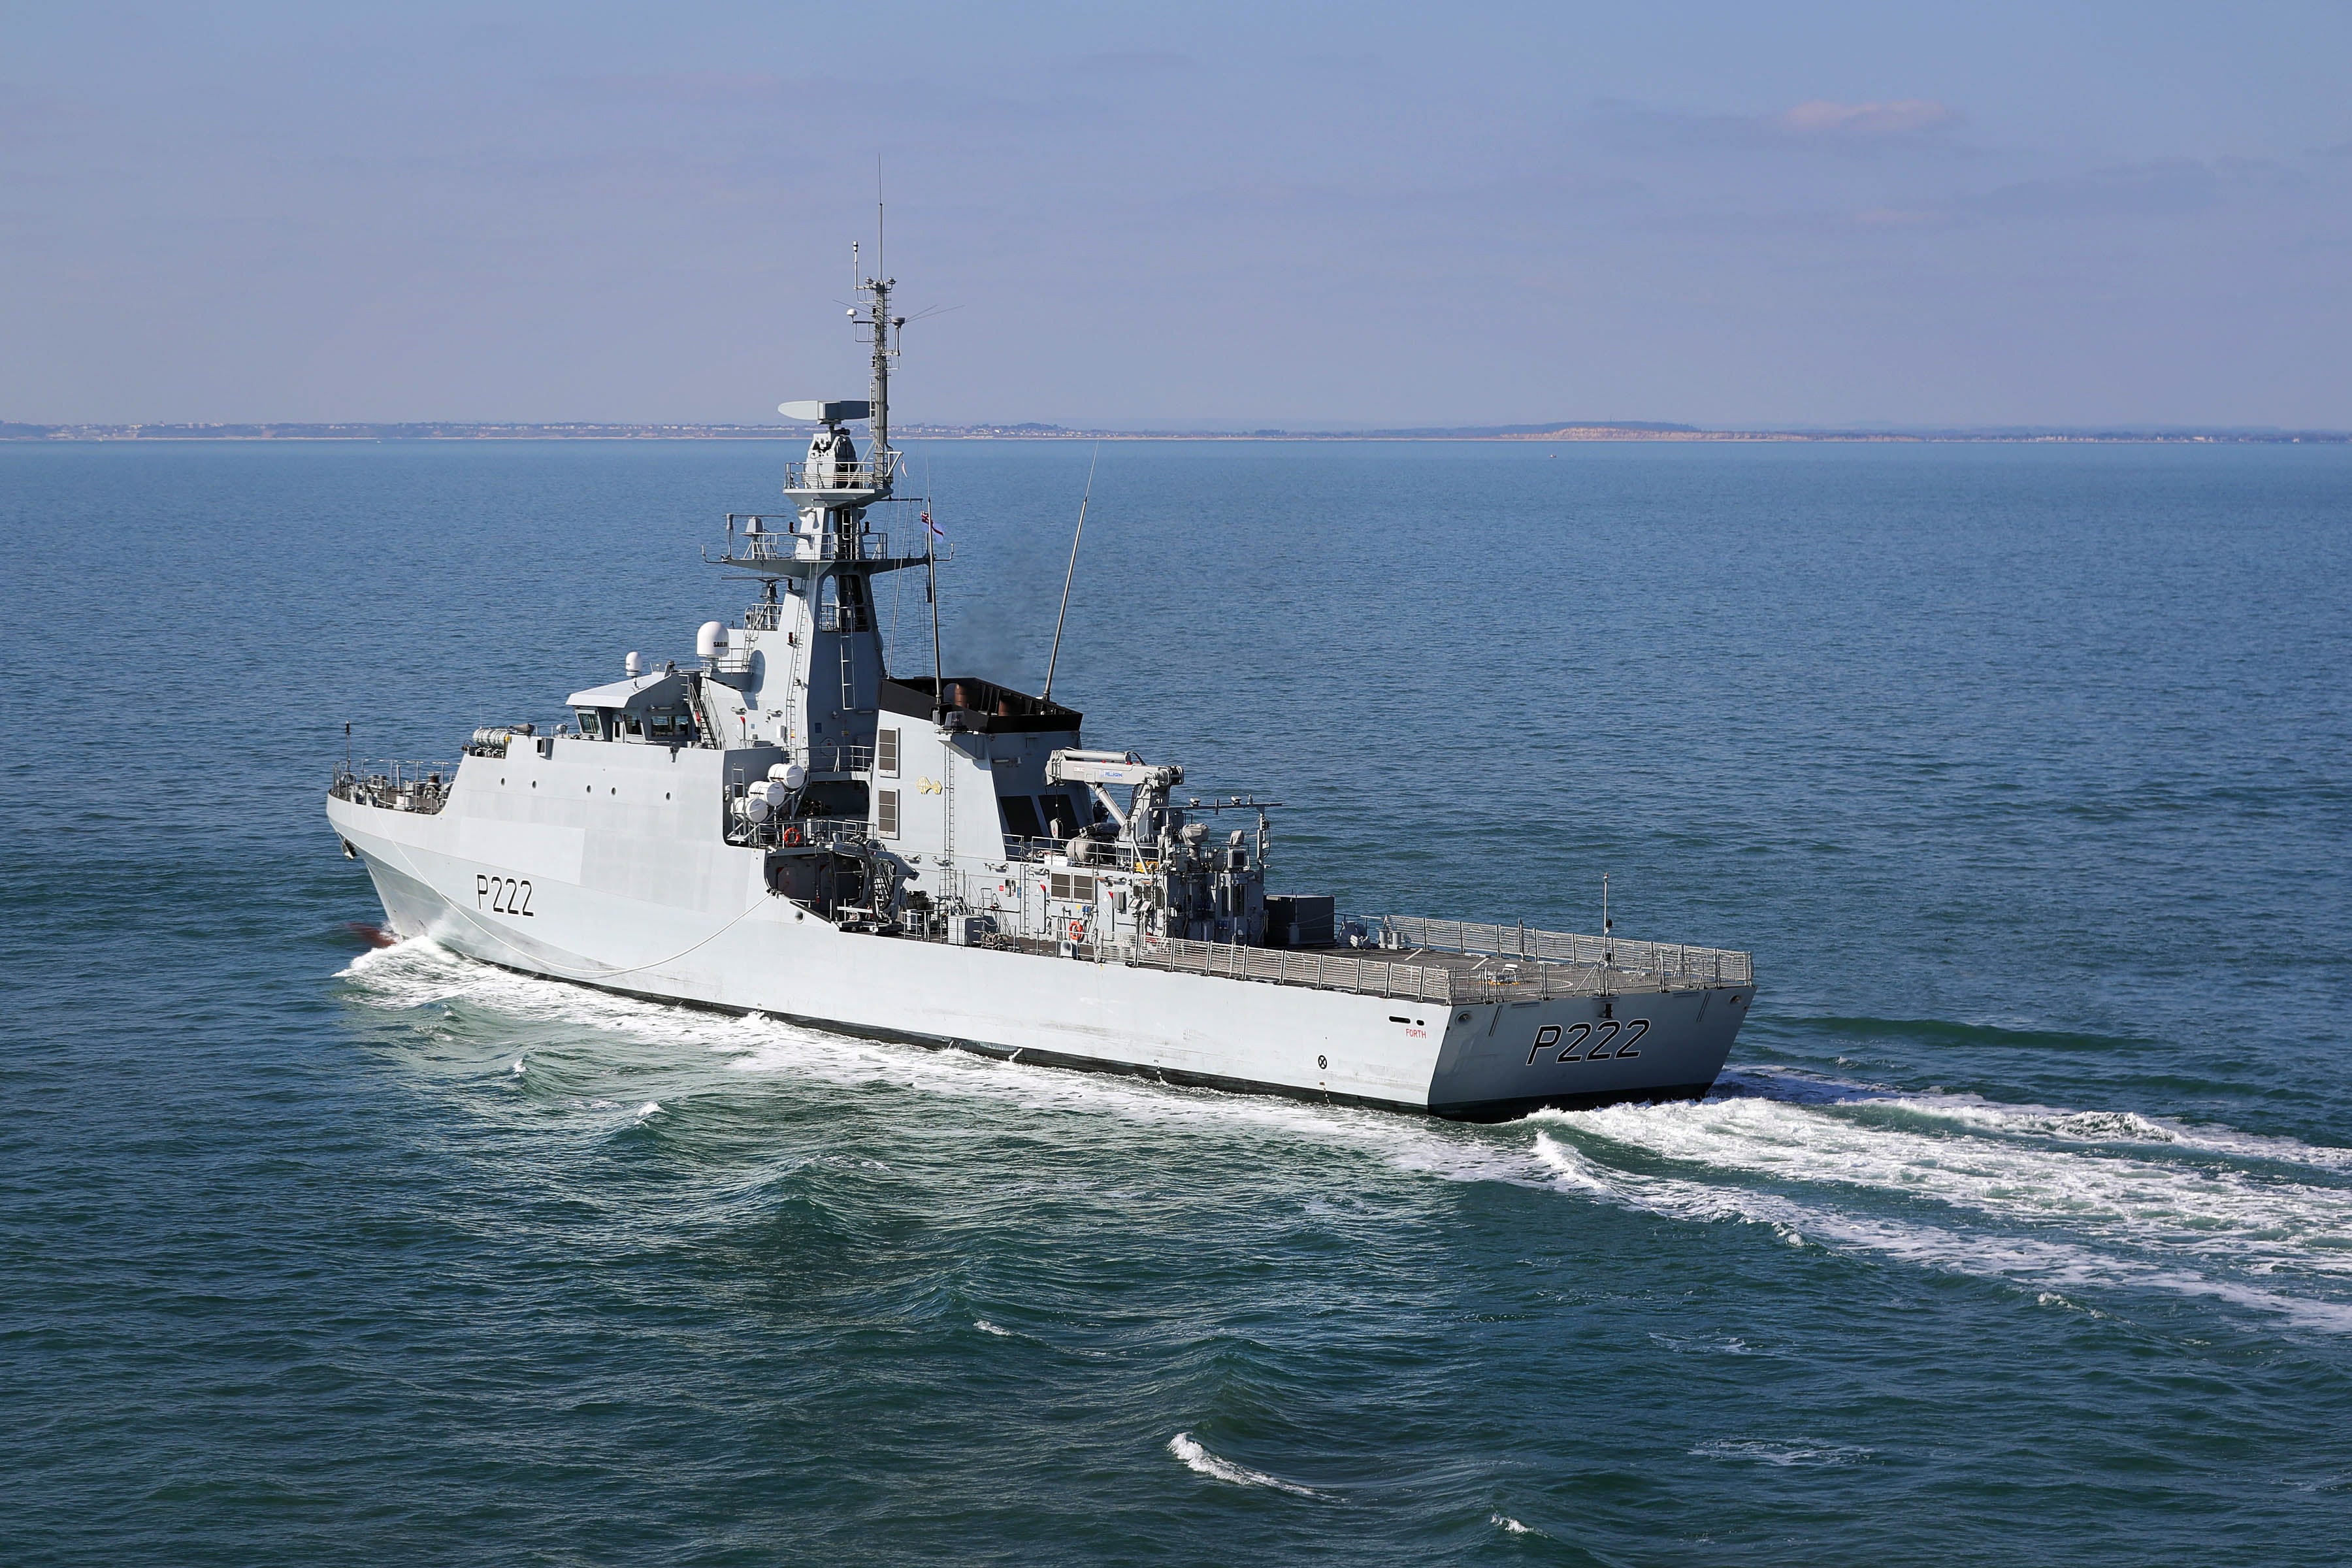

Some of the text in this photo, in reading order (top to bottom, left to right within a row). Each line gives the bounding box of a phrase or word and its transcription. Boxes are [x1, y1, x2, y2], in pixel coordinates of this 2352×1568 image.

[476, 874, 534, 917] P222
[1406, 1028, 1426, 1039] FORTH
[1526, 1019, 1650, 1066] P222
